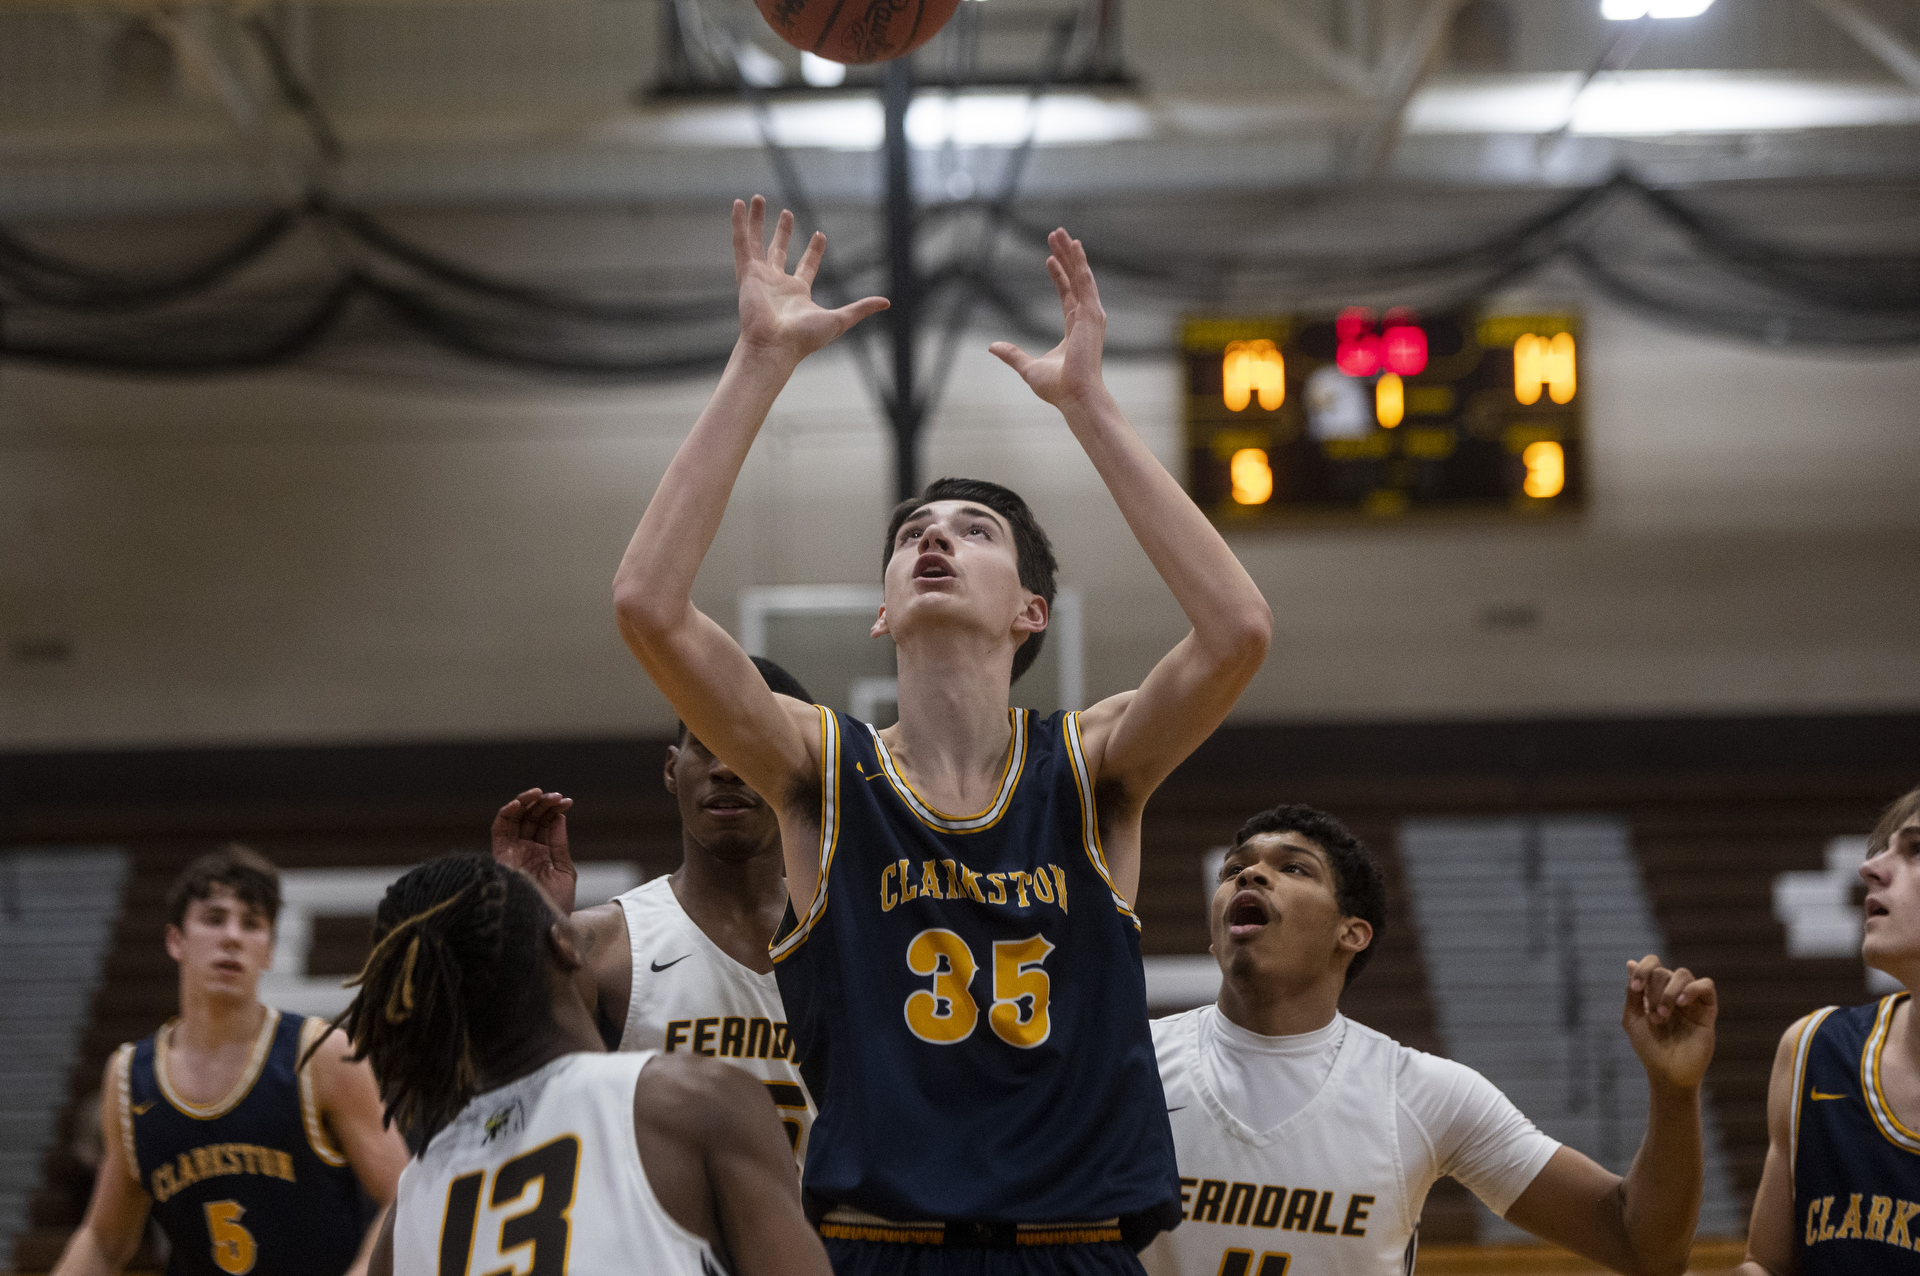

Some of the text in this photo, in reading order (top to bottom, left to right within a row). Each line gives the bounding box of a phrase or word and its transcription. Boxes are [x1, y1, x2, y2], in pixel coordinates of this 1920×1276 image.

[881, 859, 1068, 916] CLARKSTON
[904, 928, 1056, 1049] 35
[665, 1016, 801, 1067] FERND
[203, 1198, 259, 1276] 5
[437, 1131, 583, 1276] 13
[1805, 1193, 1920, 1253] CLARK
